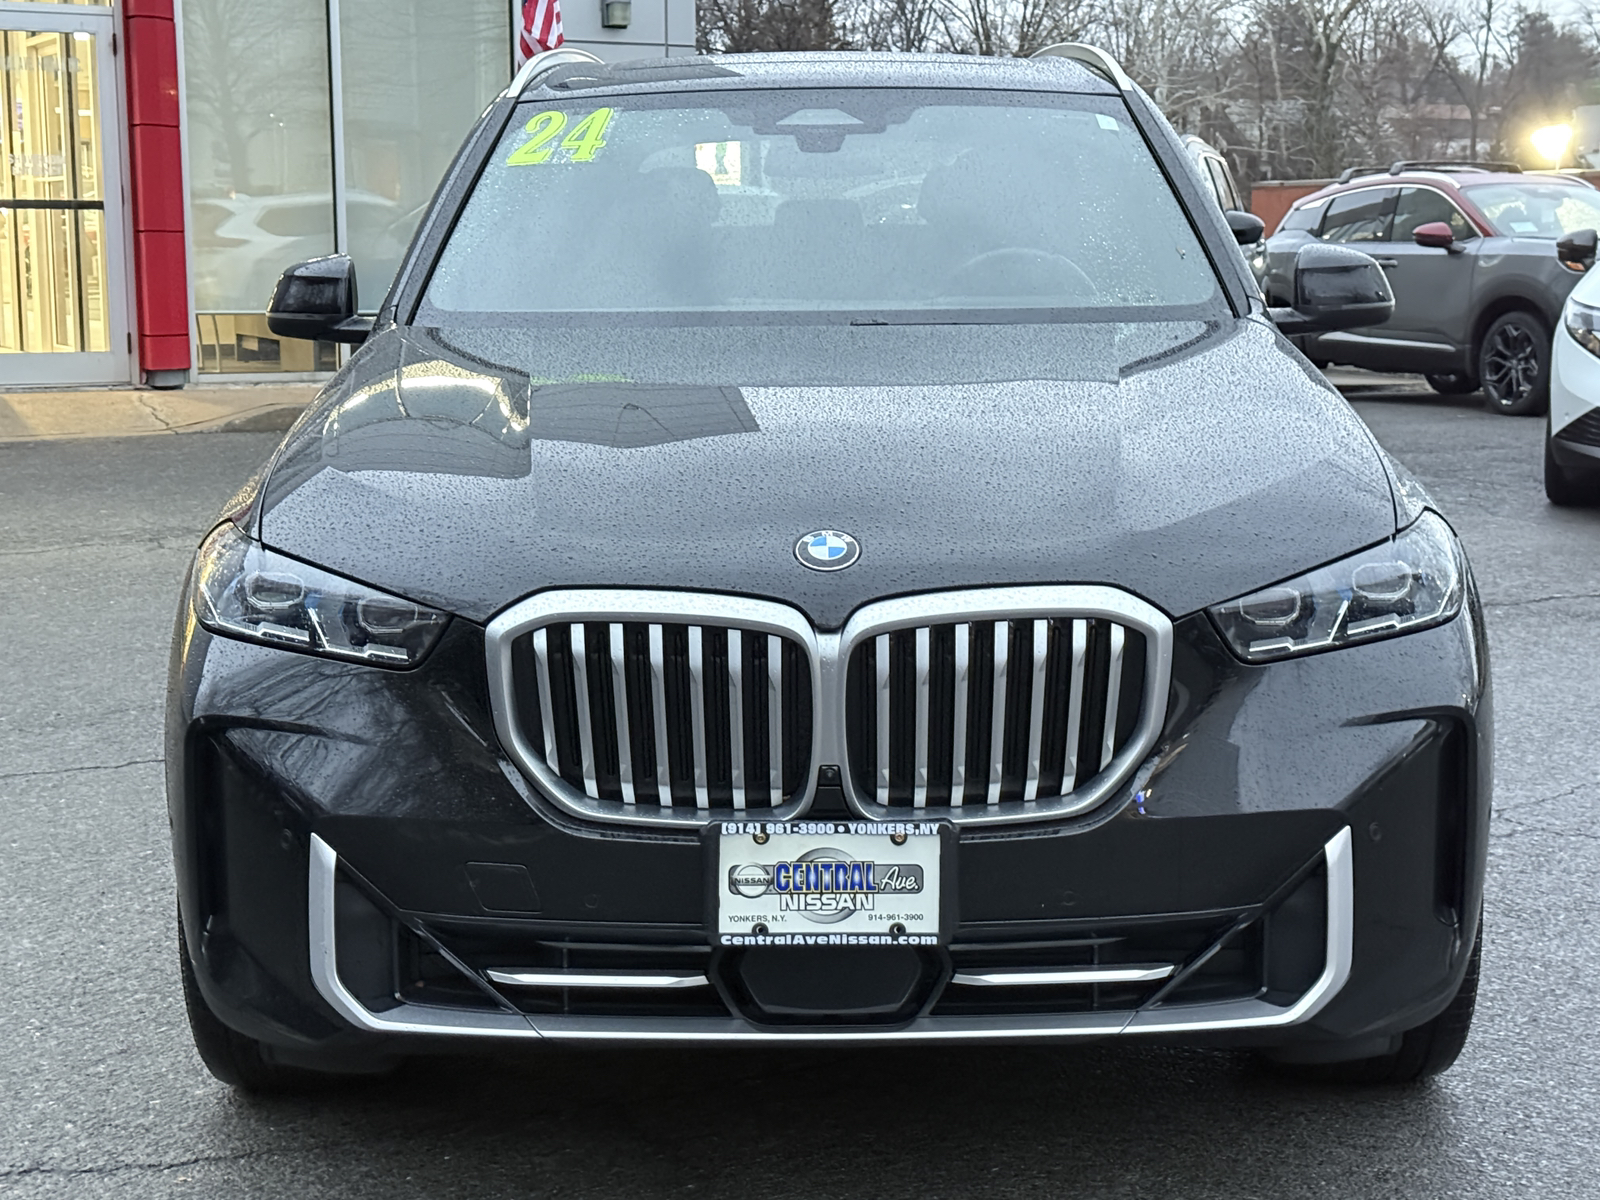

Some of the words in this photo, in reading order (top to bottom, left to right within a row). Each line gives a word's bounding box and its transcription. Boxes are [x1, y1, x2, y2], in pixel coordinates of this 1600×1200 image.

[506, 107, 614, 167] 24
[766, 823, 836, 835] 961-3900
[735, 877, 770, 885] NISSAN
[774, 861, 879, 894] CENTRAL
[880, 867, 918, 891] Ave.
[780, 894, 874, 911] NISSAN
[728, 915, 770, 924] YONKERS,
[771, 915, 788, 923] N.Y.
[868, 914, 923, 923] 914-961-3900
[721, 935, 938, 946] CentralAveNissan.com
